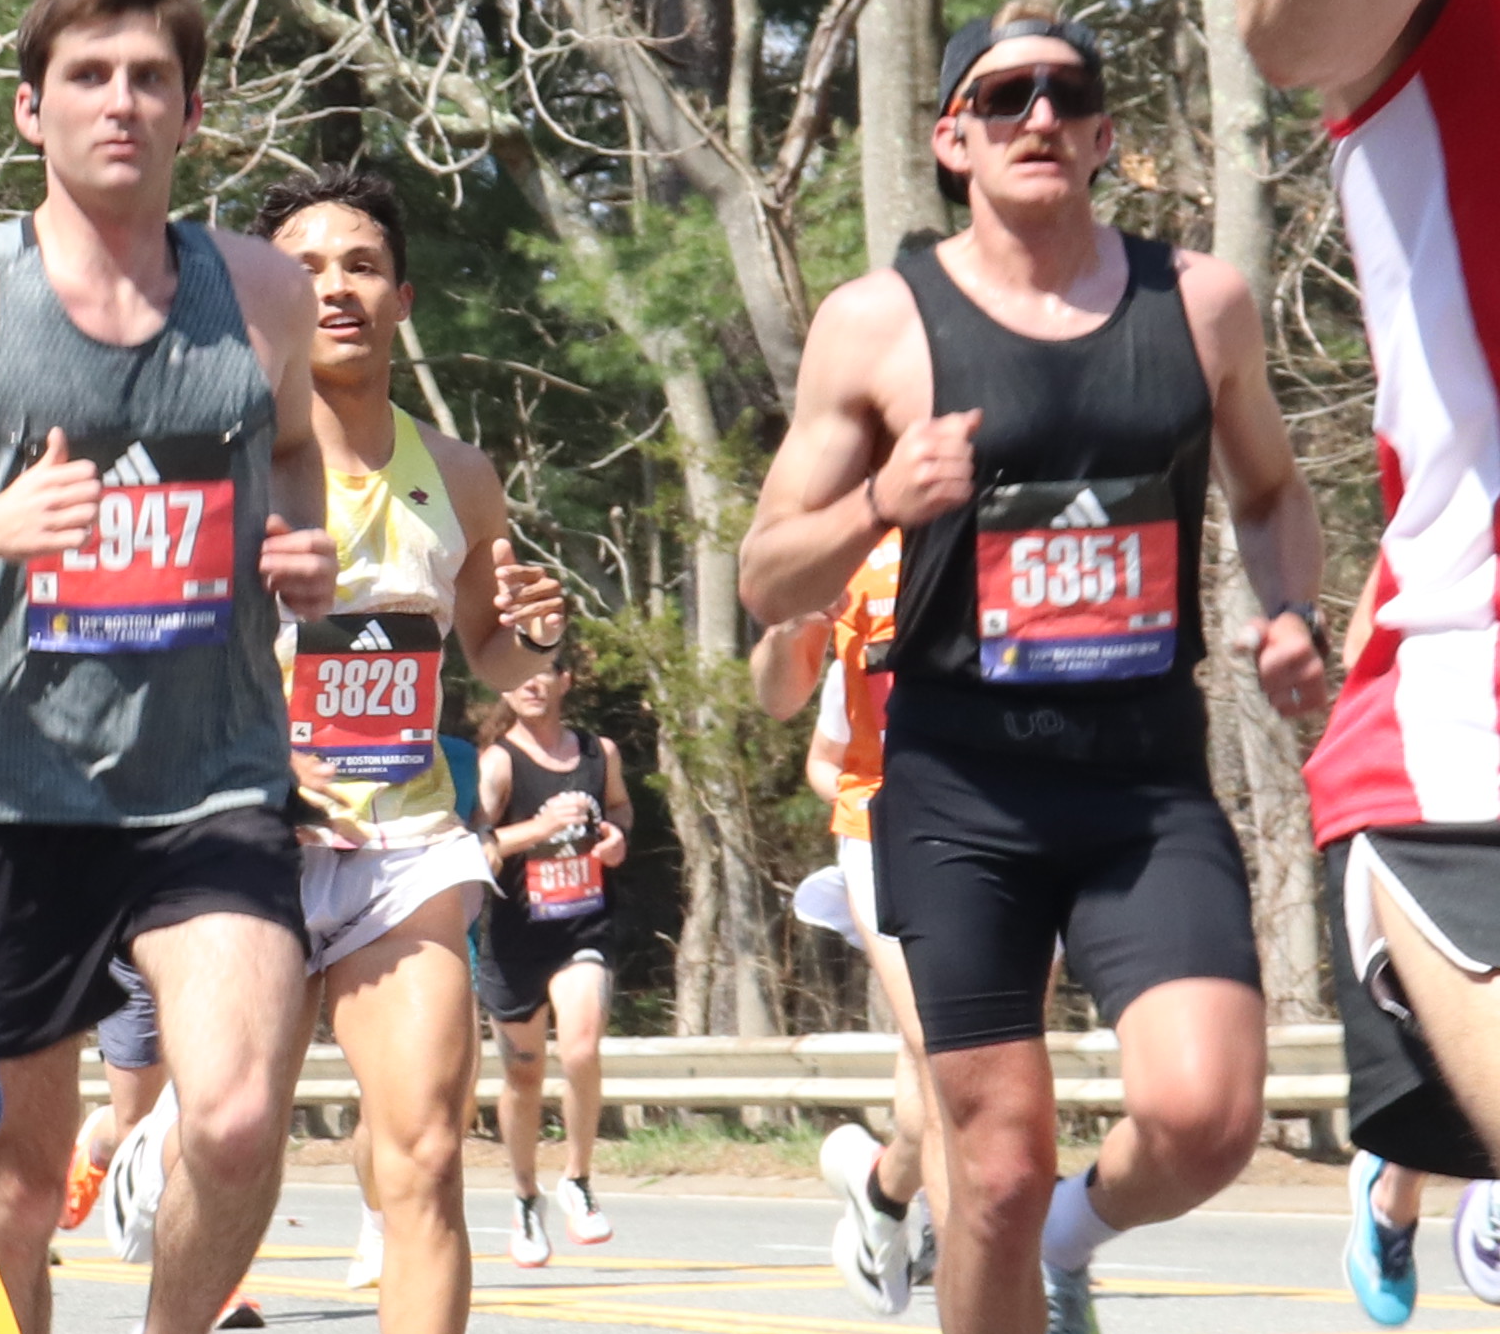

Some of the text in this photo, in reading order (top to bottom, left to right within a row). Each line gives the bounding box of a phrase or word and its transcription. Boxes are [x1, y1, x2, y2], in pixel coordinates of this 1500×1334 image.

[1010, 532, 1143, 608] 5351
[315, 658, 419, 717] 3828
[346, 754, 381, 766] BOSTON
[381, 753, 426, 766] MARATHON
